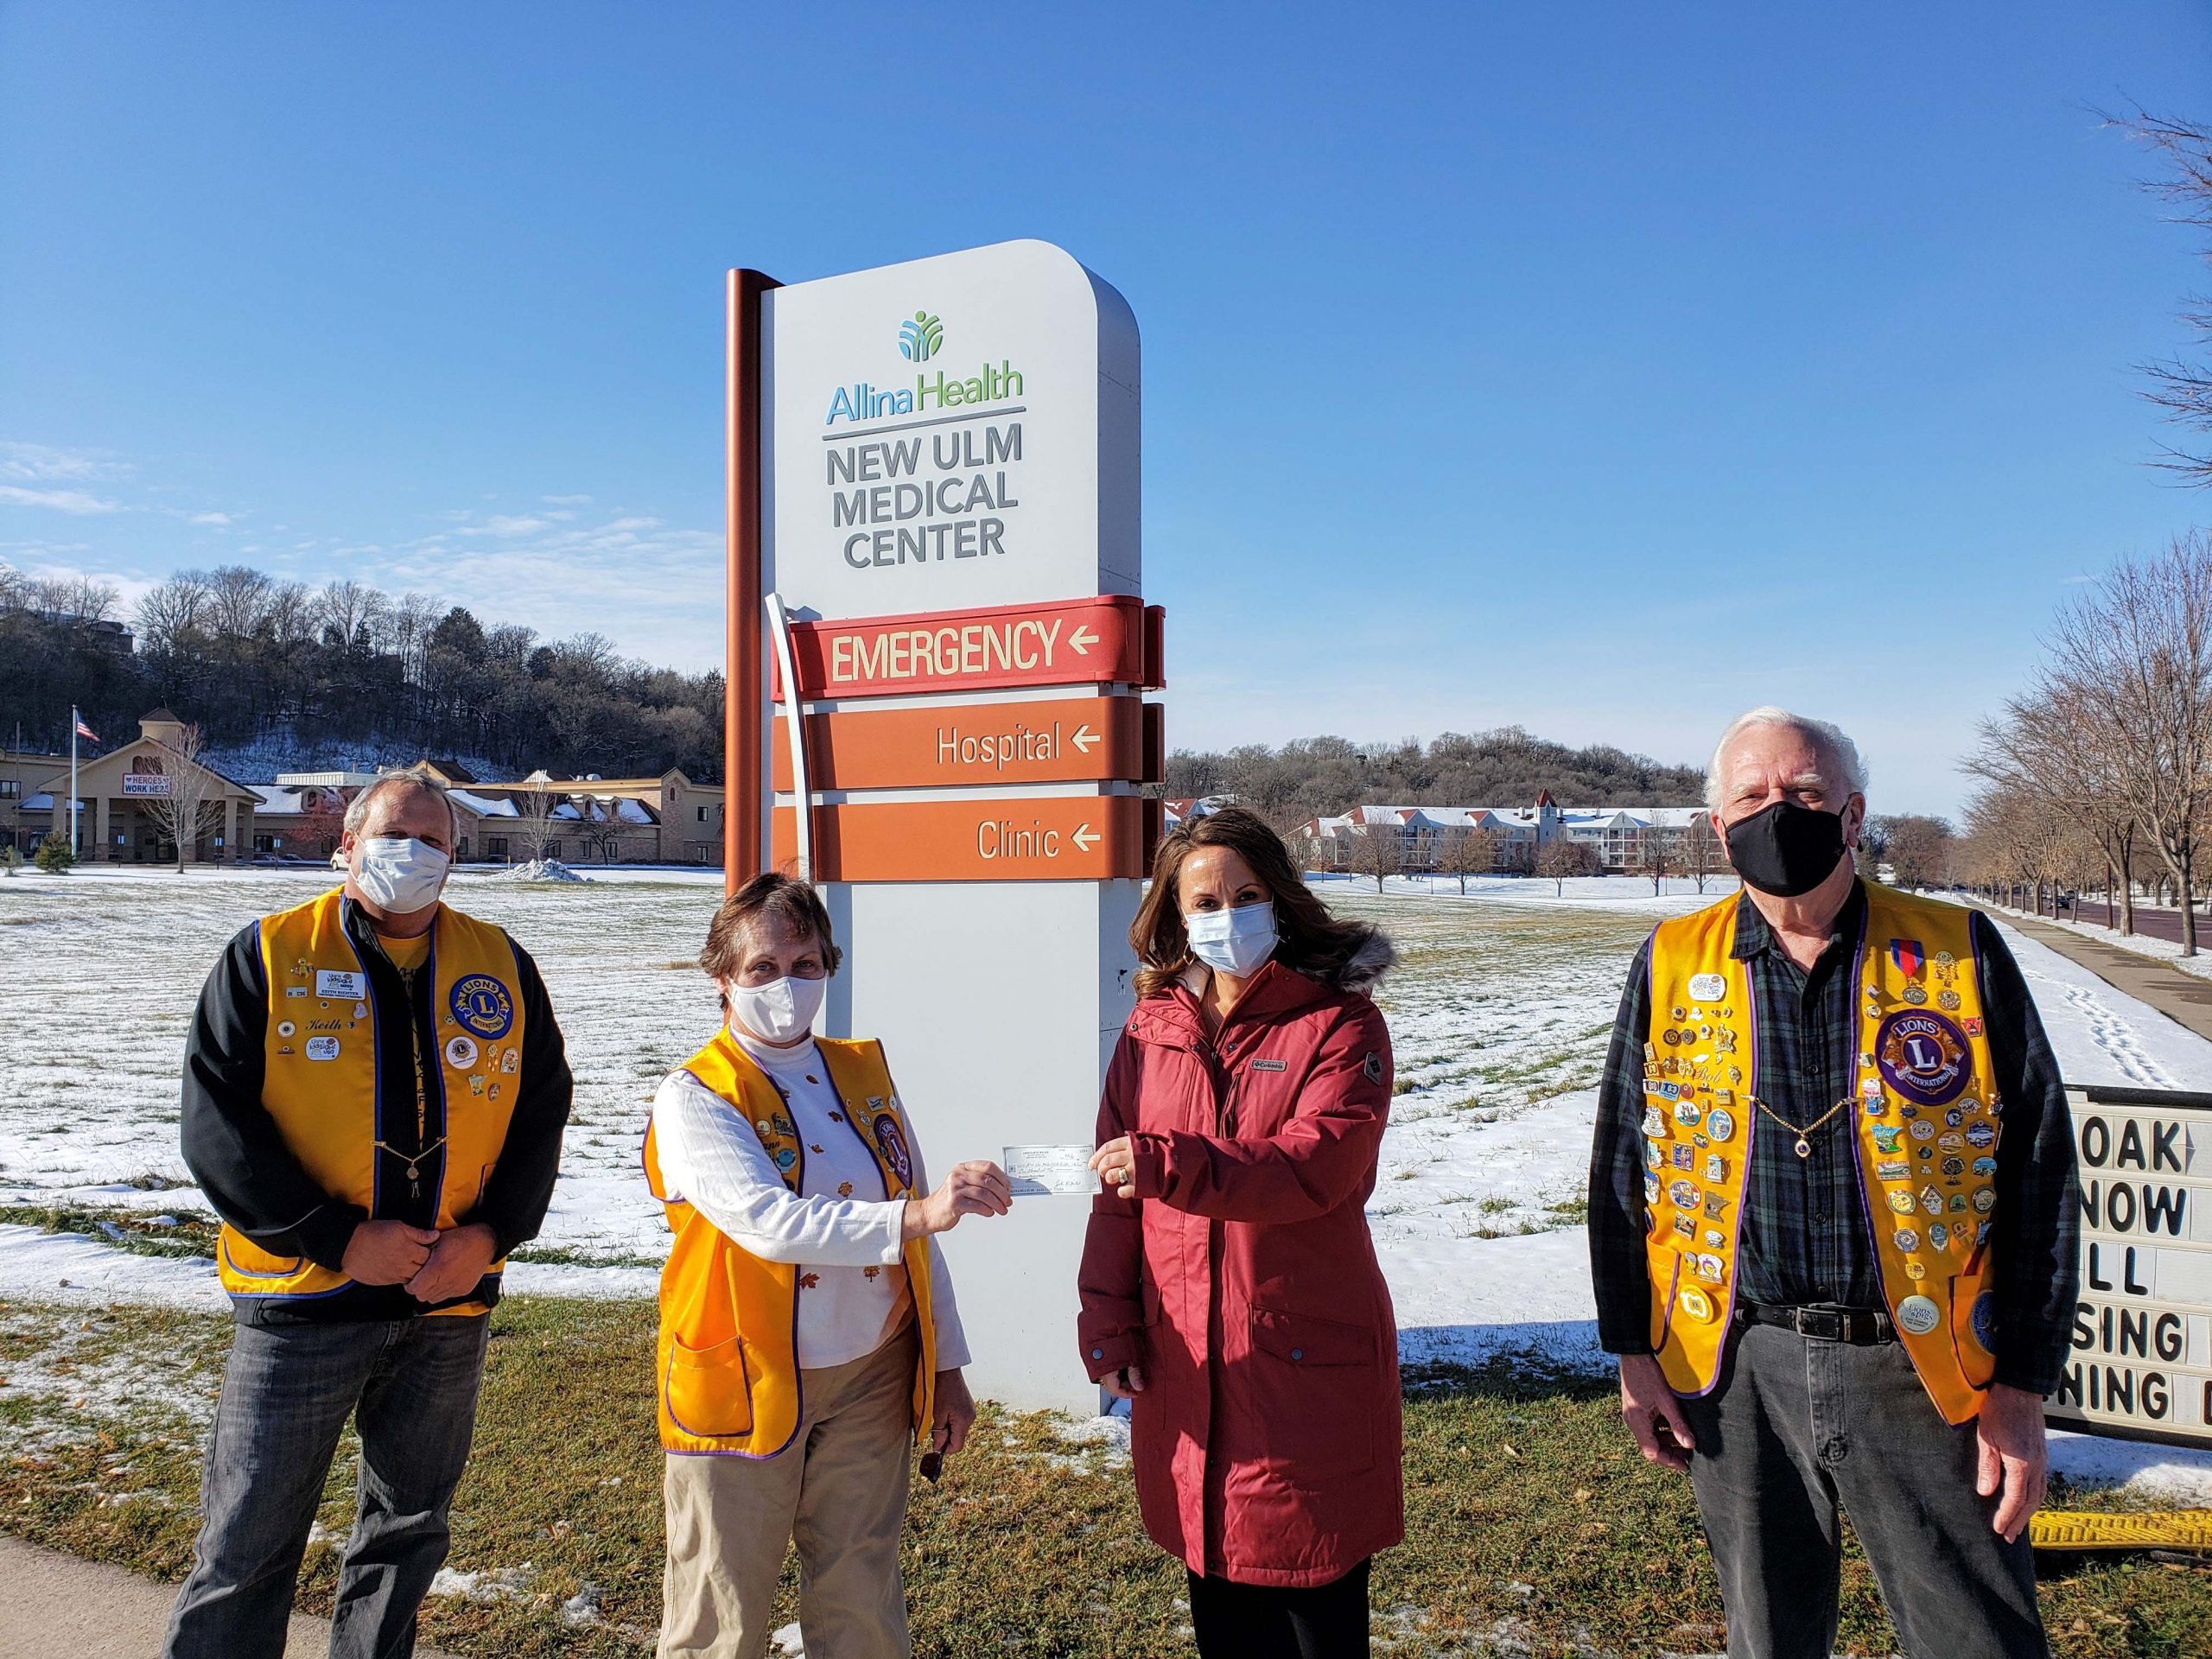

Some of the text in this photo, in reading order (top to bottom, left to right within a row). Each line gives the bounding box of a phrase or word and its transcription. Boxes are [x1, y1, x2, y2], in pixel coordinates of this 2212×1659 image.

[824, 359, 1023, 425] Allina Health
[826, 423, 1021, 486] NEW ULM
[833, 471, 1019, 527] MEDICAL
[843, 518, 1005, 569] CENTER
[831, 619, 1062, 683] EMERGENCY
[937, 721, 1060, 770] Hospital
[132, 776, 162, 785] HEROES
[976, 819, 1059, 860] Clinic
[464, 980, 498, 993] LIONS
[477, 995, 495, 1014] L
[305, 1019, 342, 1031] Keith
[1895, 1020, 1936, 1037] LIONS
[1695, 1065, 1722, 1084] Bob
[1905, 1071, 1952, 1087] INTERNATIONAL
[1907, 1039, 1937, 1069] L
[2082, 1116, 2182, 1173] OAK
[2081, 1179, 2187, 1236] NOW
[2089, 1243, 2149, 1296] LL
[2072, 1301, 2183, 1362] SING
[2043, 1362, 2169, 1420] NING
